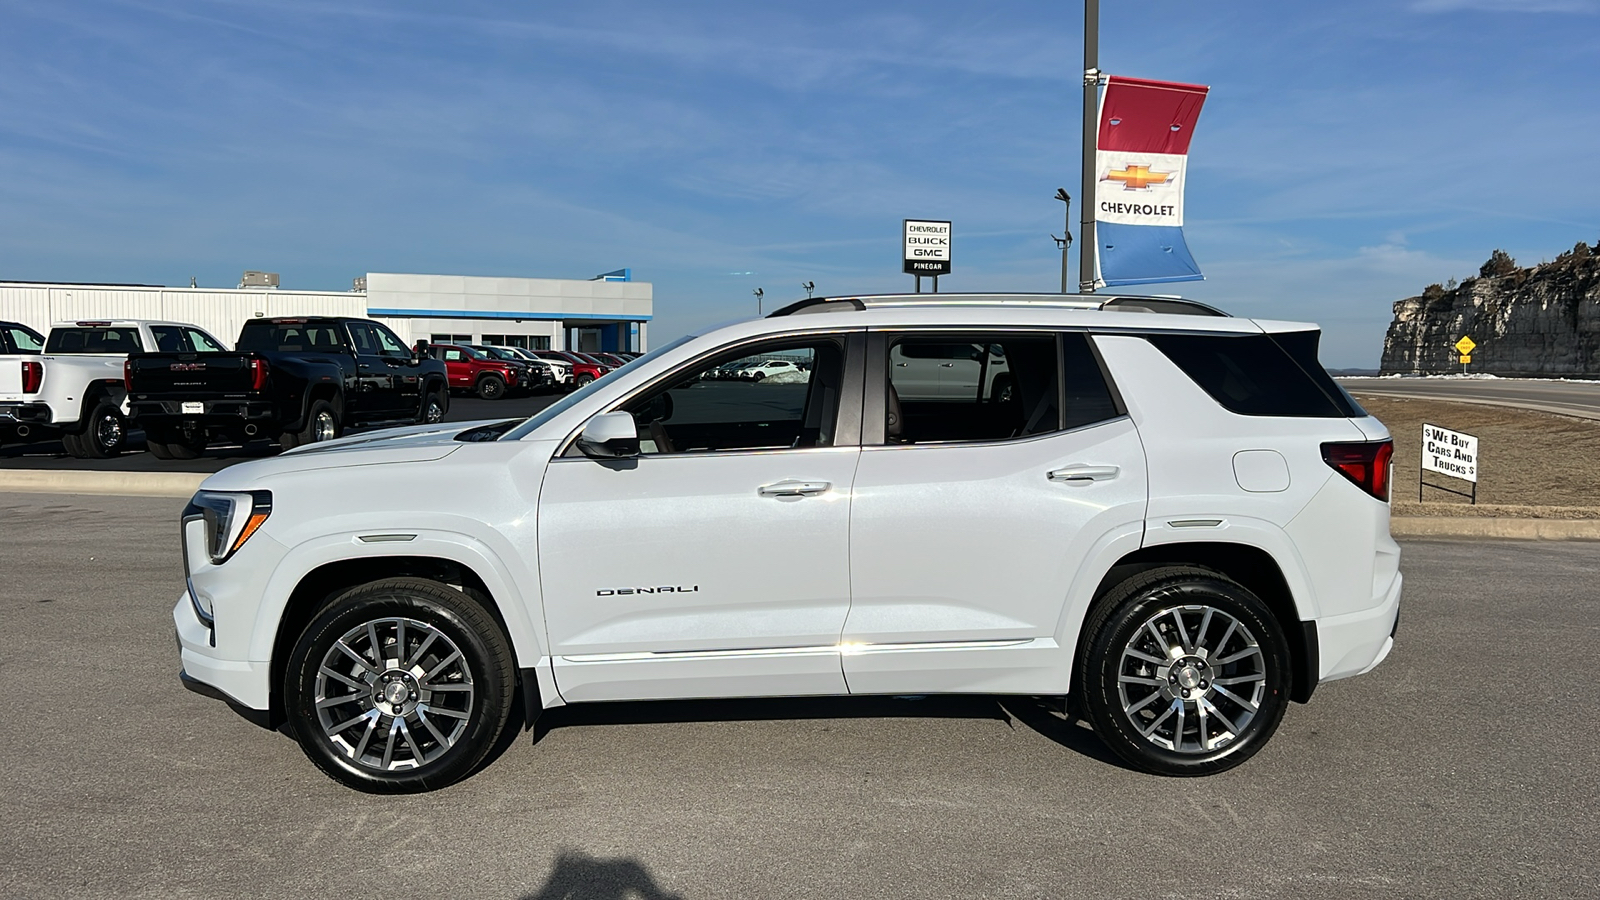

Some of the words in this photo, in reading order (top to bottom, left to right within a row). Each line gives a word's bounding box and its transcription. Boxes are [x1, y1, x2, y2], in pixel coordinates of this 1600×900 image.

[1101, 201, 1174, 216] CHEVROLET
[909, 225, 947, 233] CHEVROLET
[908, 237, 947, 245] BUICK
[914, 249, 942, 257] GMC
[913, 262, 942, 270] PINEGAR
[170, 363, 206, 371] GMC
[597, 585, 699, 596] DENALI
